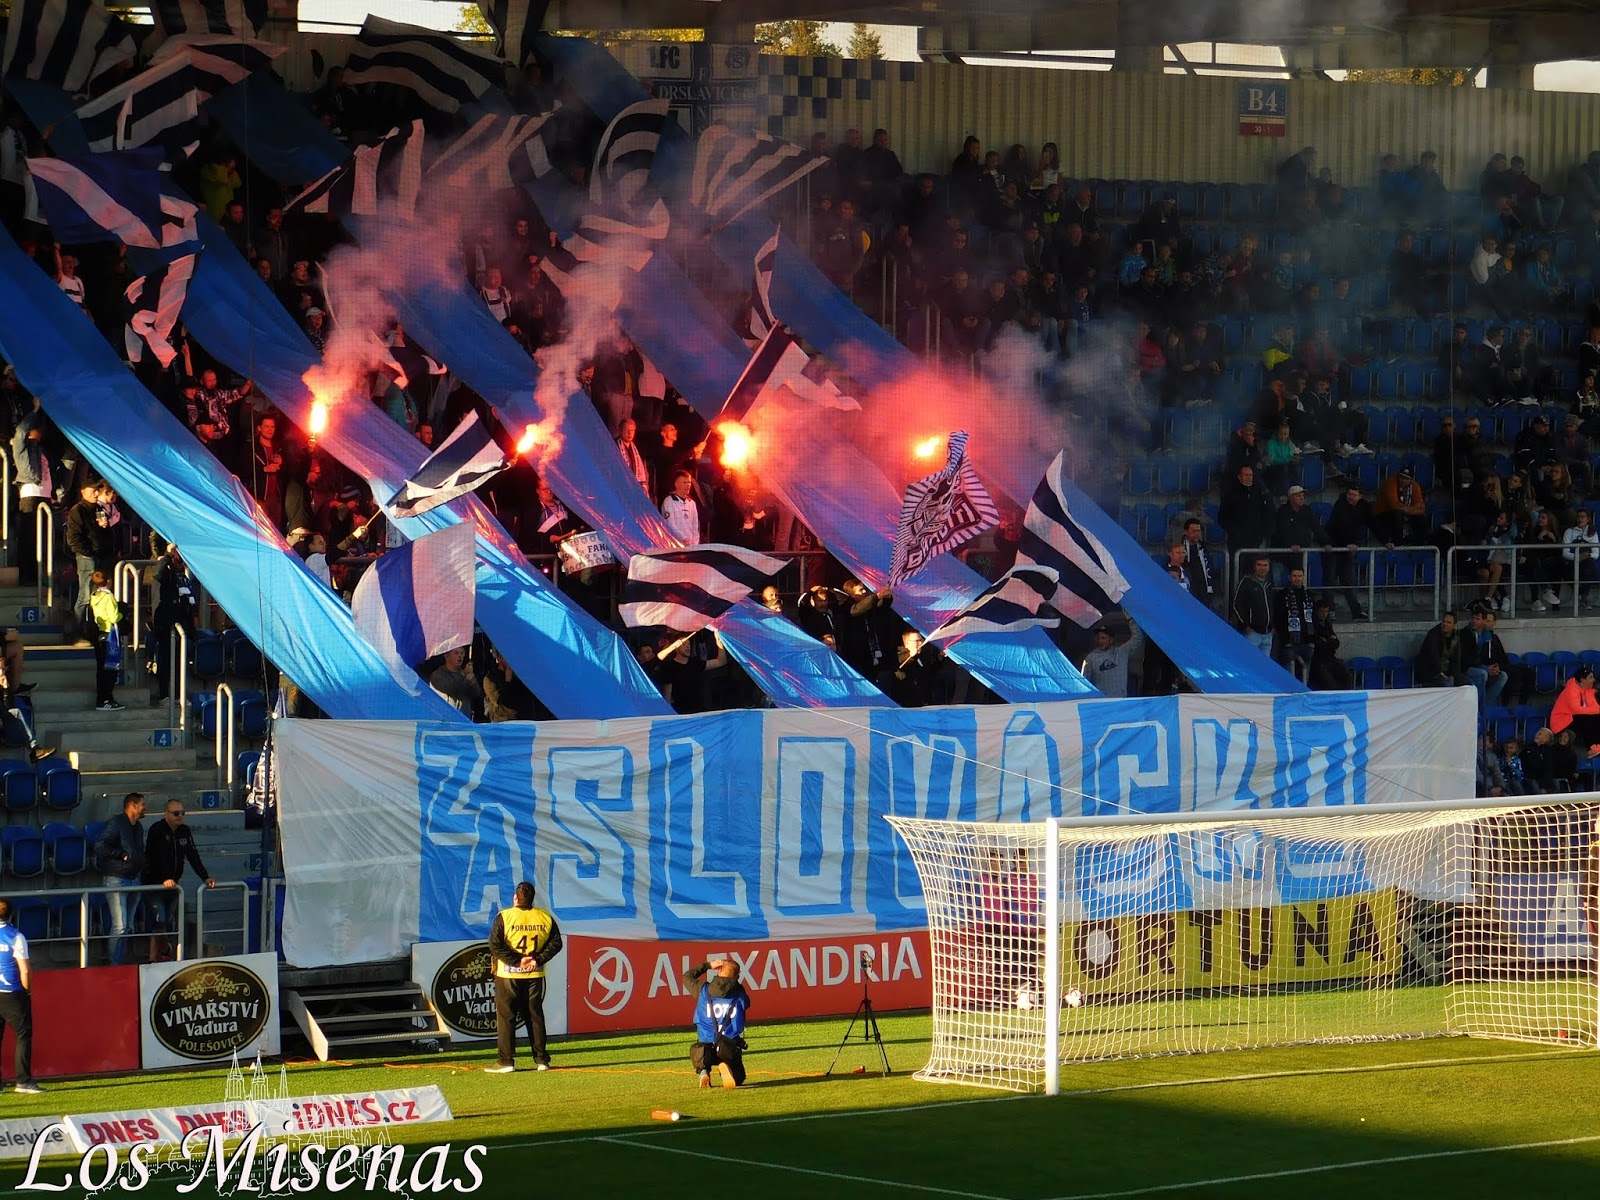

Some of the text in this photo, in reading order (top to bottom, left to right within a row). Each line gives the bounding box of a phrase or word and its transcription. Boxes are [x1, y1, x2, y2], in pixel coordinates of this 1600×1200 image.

[658, 85, 738, 101] DRSLAVICE
[1248, 88, 1277, 112] B4
[27, 610, 34, 622] 6
[159, 732, 167, 745] 4
[208, 794, 215, 806] 3
[255, 858, 262, 870] 2
[515, 934, 539, 955] 41
[647, 936, 922, 998] ALEXANDRIA
[443, 979, 496, 1005] VINAŘ
[162, 998, 260, 1028] VINAŘSTVÍ
[185, 1020, 238, 1037] Vaďura
[178, 1032, 245, 1052] POLEŠOVICE
[82, 1118, 160, 1145] DNES
[292, 1097, 421, 1130] iDNES.cz
